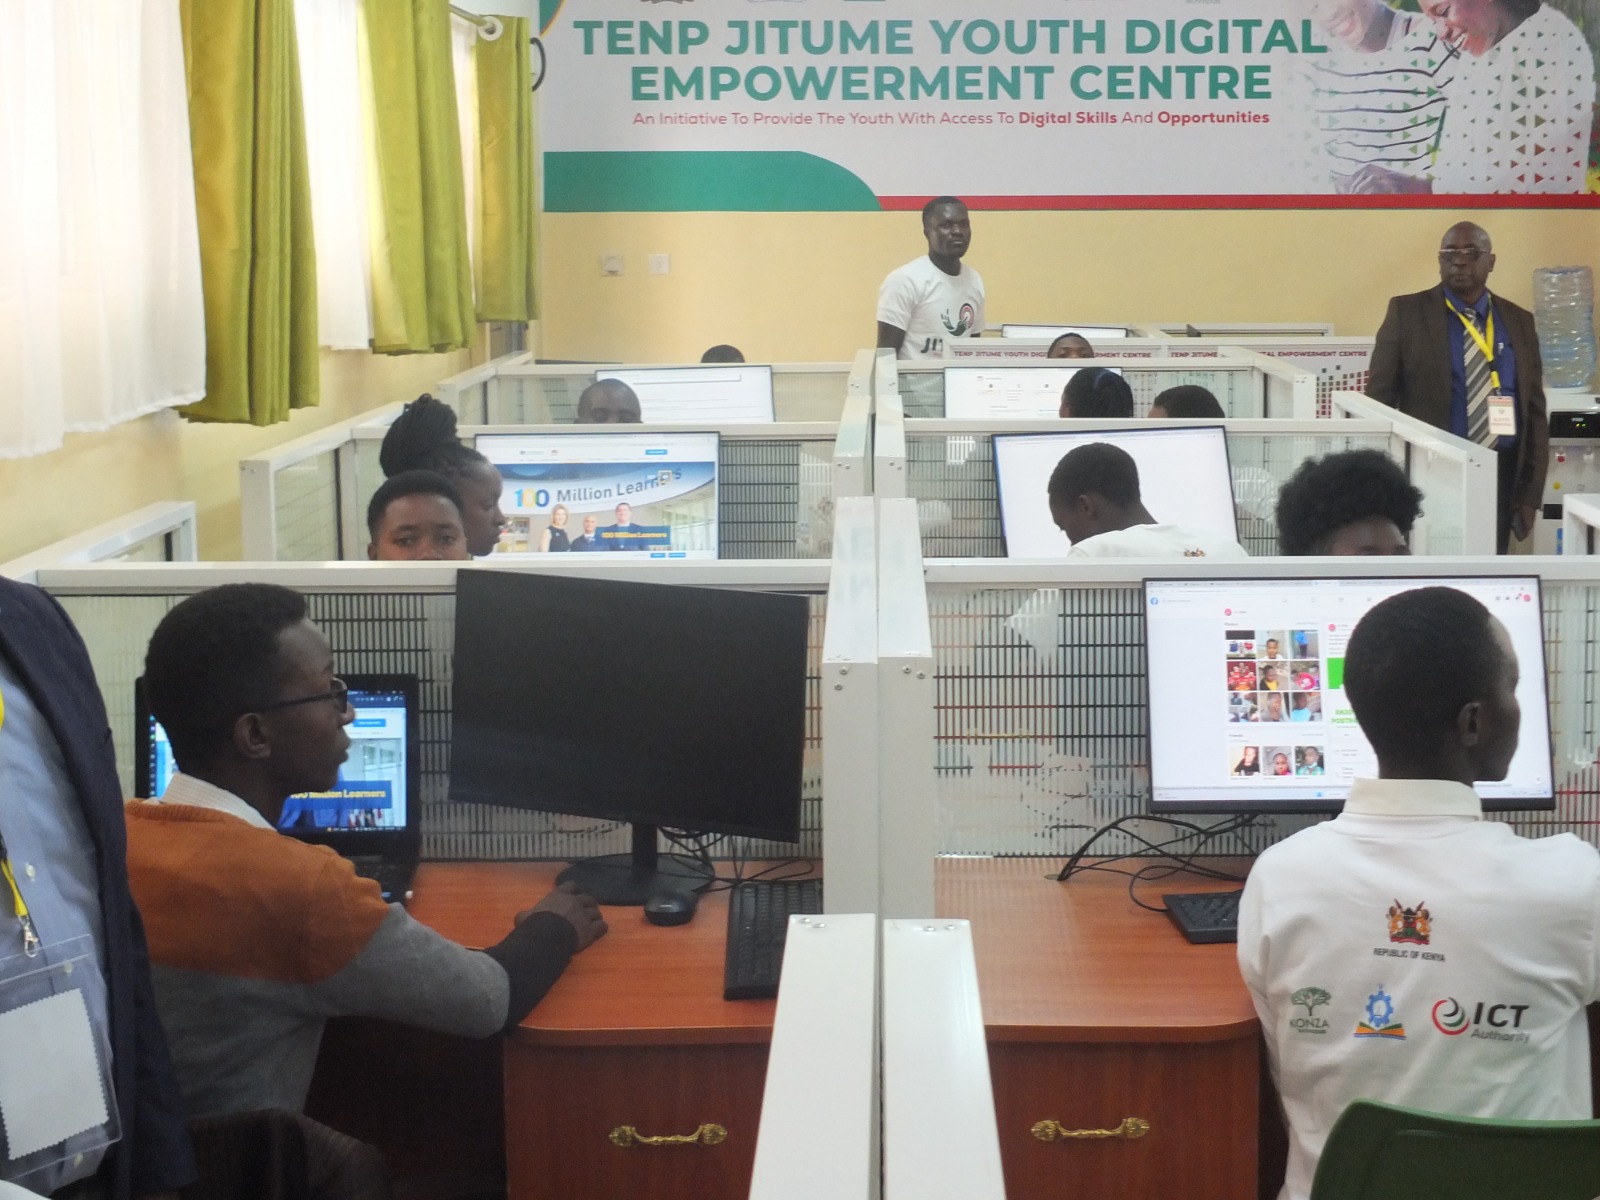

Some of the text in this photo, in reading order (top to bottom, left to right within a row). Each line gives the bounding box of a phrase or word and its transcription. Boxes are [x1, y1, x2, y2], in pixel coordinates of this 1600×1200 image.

[574, 19, 1328, 55] TENP JITUME YOUTH DIGITAL
[631, 65, 1272, 101] EMPOWERMENT CENTRE
[633, 111, 1270, 128] An Initiative To Provide The Youth With Access To Digital Skills And Opportunities
[514, 488, 550, 508] 100
[556, 489, 612, 502] Million
[1373, 947, 1446, 962] REPUBLIC OF KENYA
[1289, 1017, 1330, 1029] KONZA
[1473, 1002, 1530, 1028] ICT
[1470, 1028, 1530, 1044] Authority
